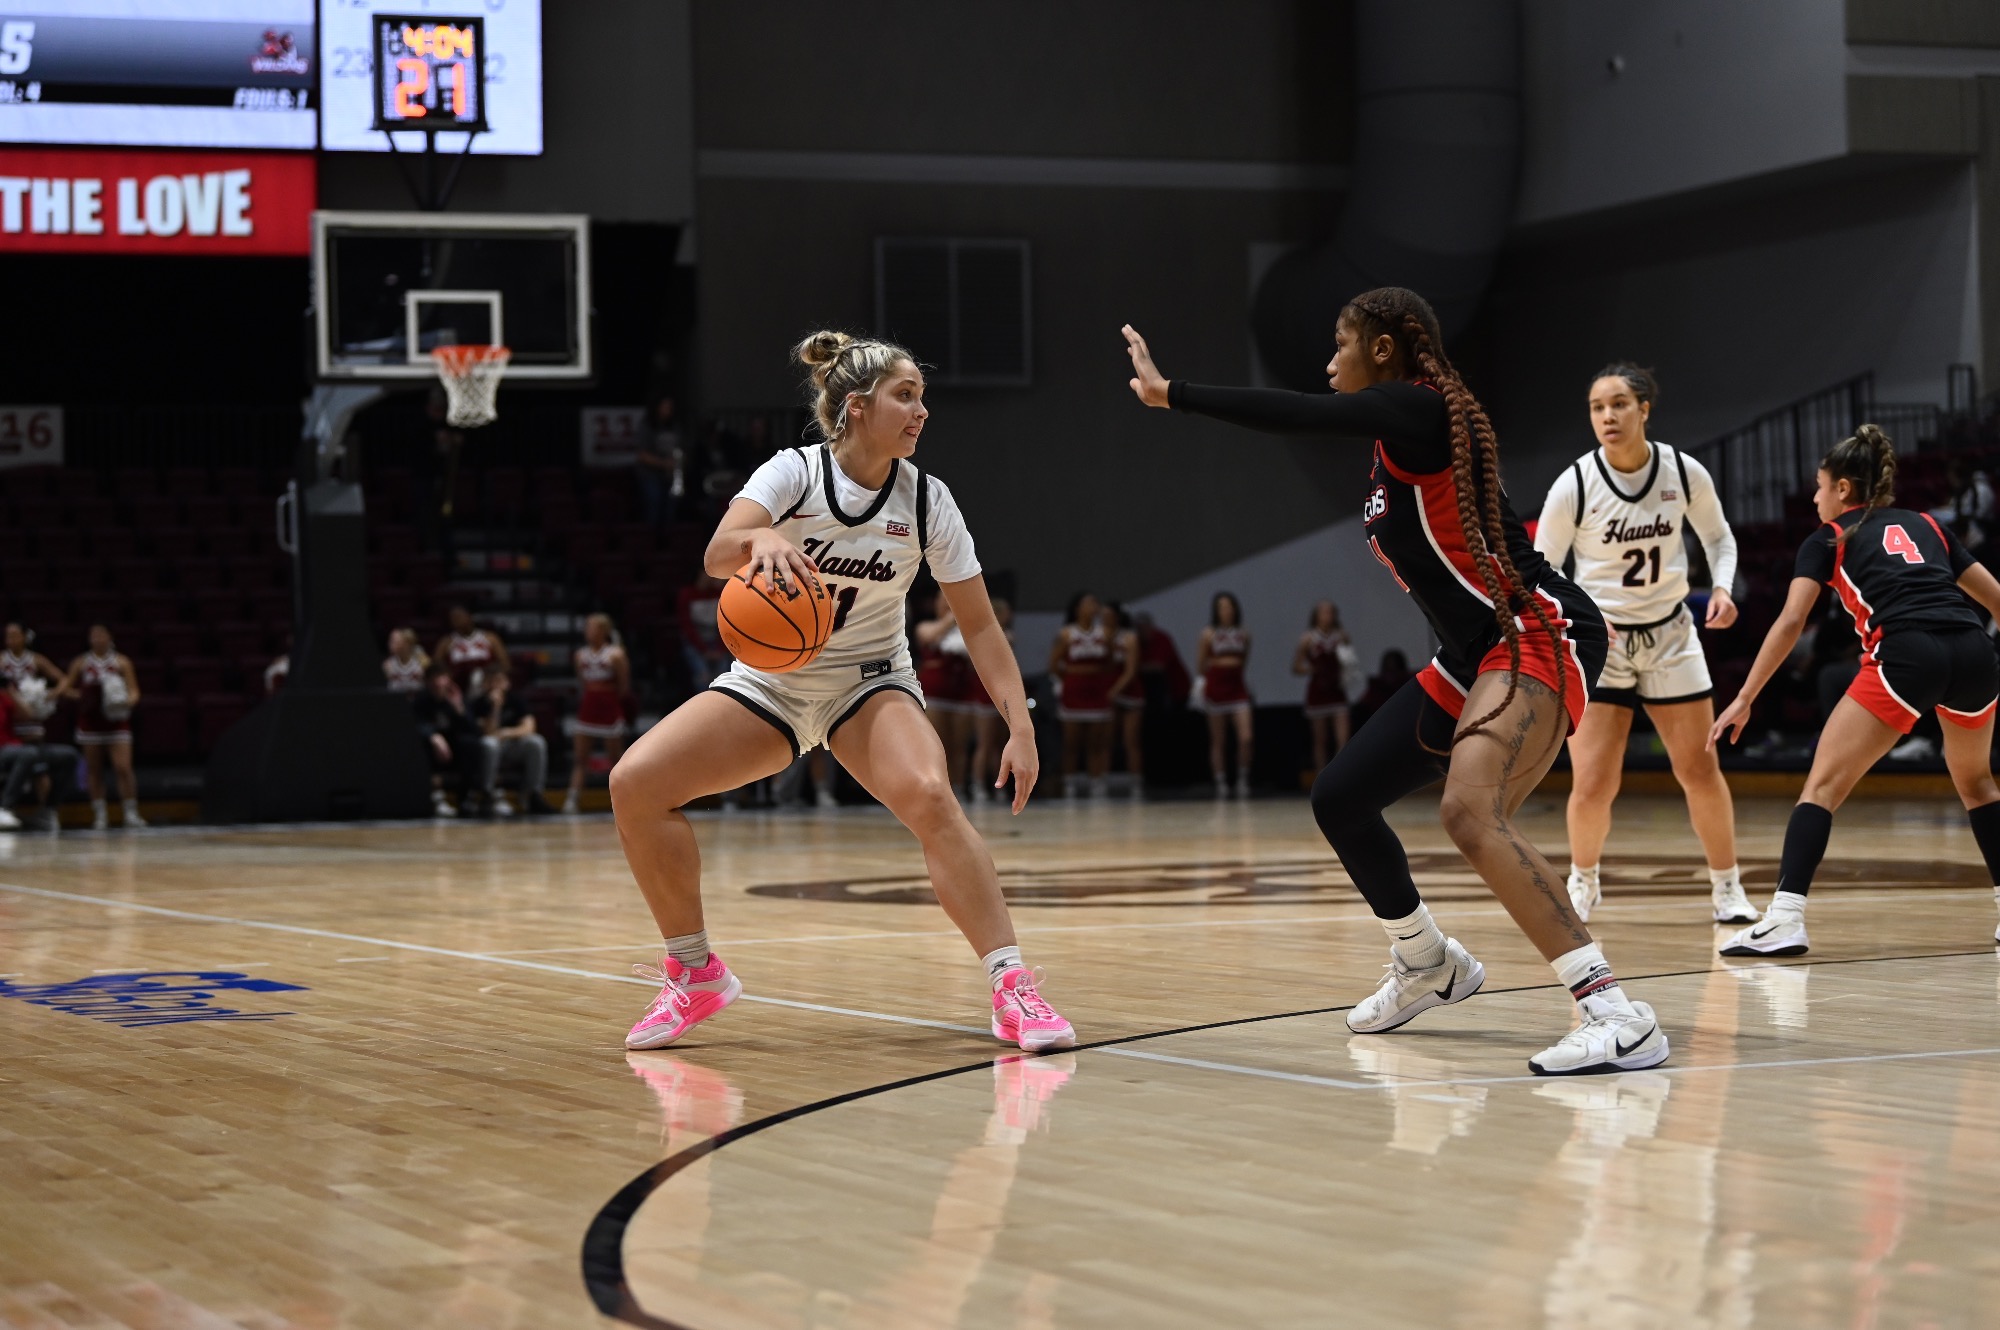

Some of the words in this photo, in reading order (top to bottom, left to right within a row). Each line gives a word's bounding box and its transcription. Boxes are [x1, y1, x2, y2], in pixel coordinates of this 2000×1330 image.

[402, 25, 473, 60] 4:04
[394, 58, 466, 117] 21
[0, 176, 103, 235] THE
[118, 168, 253, 237] LOVE
[887, 523, 911, 534] PSAC
[1602, 513, 1674, 544] Hawks
[1882, 524, 1925, 564] 4
[1622, 545, 1661, 587] 21
